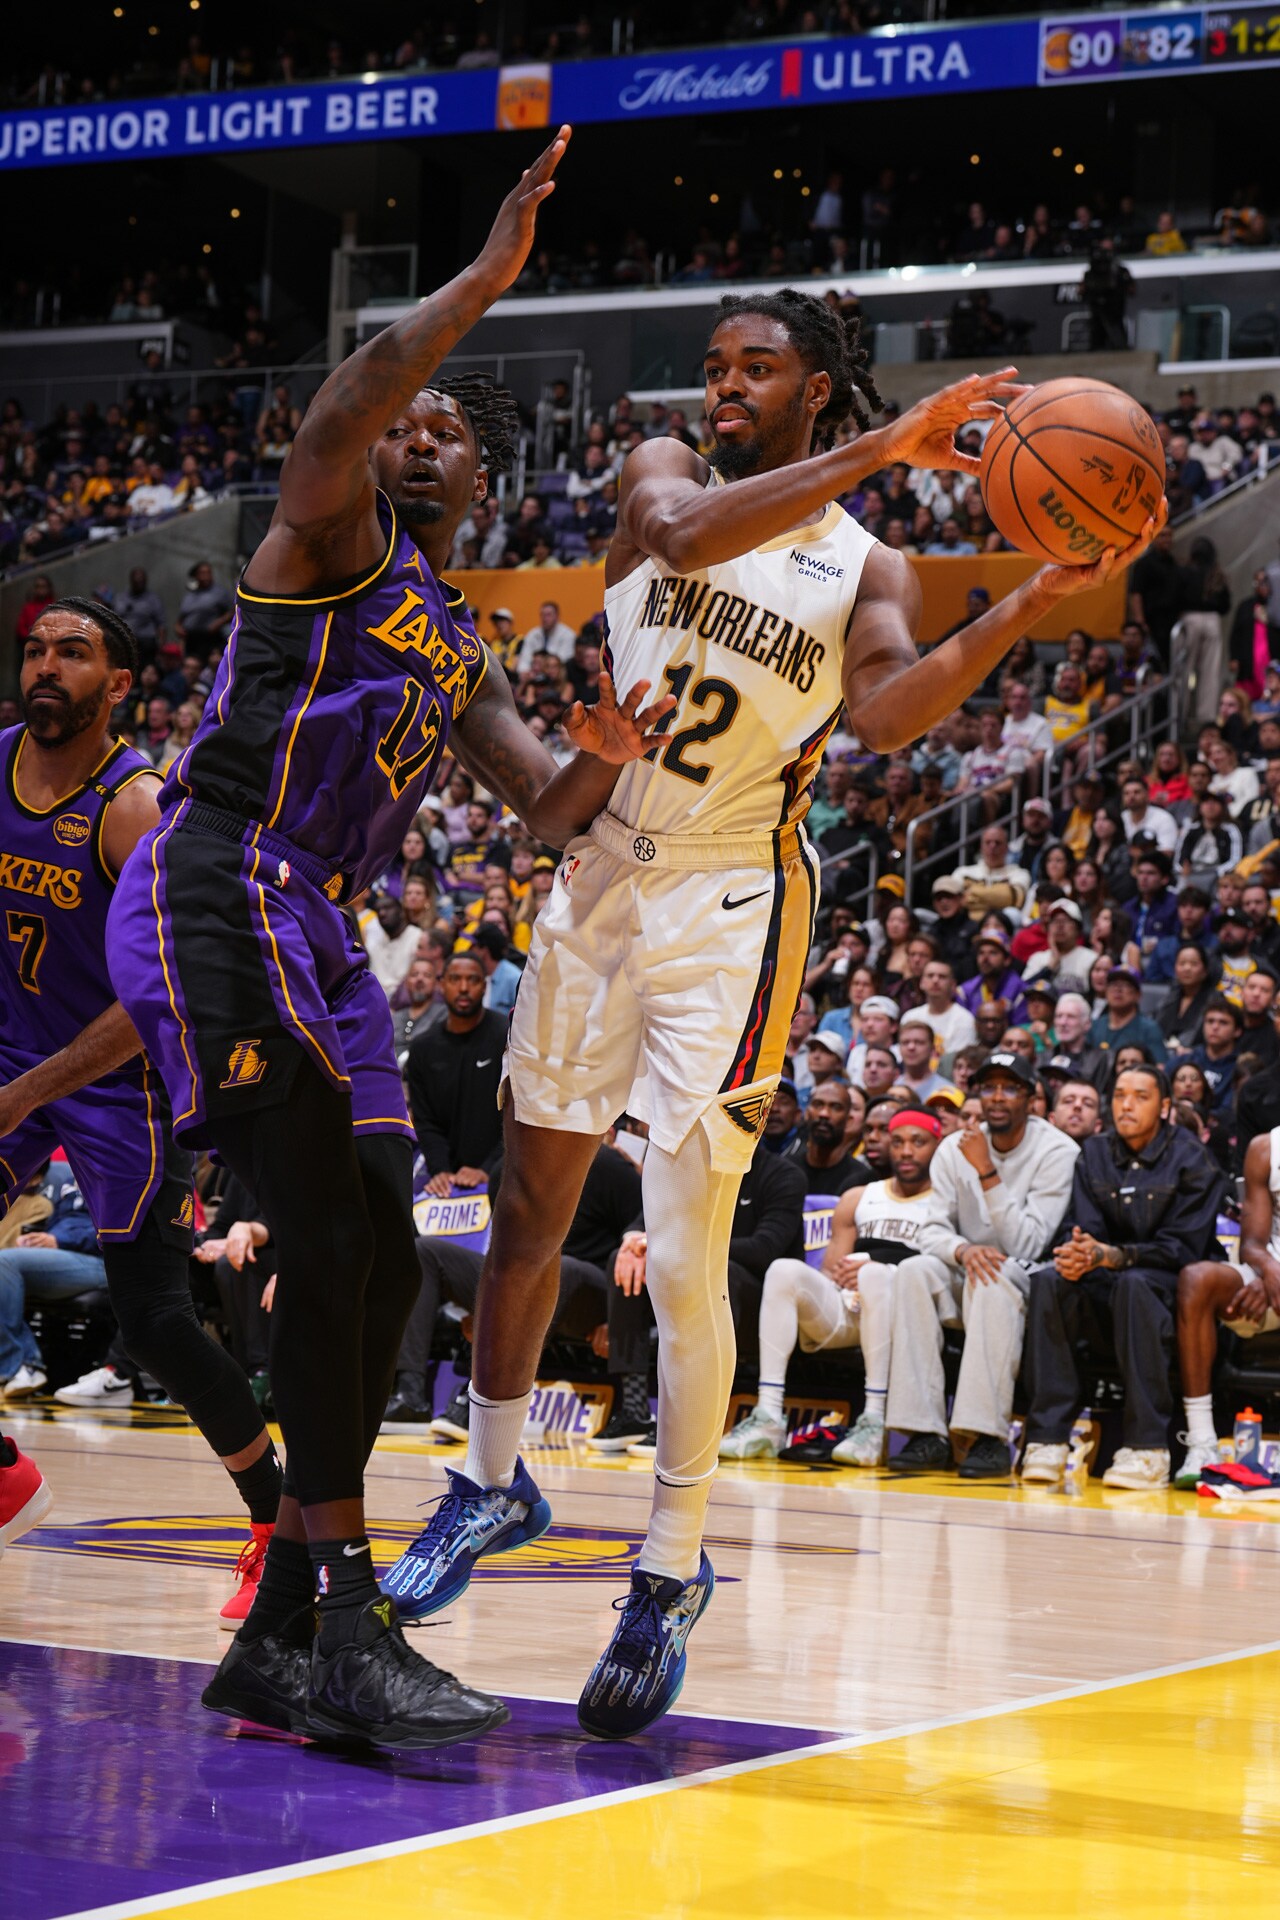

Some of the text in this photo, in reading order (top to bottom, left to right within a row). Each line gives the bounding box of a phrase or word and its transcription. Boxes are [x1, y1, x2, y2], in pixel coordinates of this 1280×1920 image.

[1068, 30, 1114, 68] 90
[1148, 23, 1194, 61] 82
[1210, 29, 1227, 56] 3
[618, 41, 970, 110] Michelob ULTRA
[185, 97, 310, 144] LIGHT
[326, 87, 439, 132] BEER
[1037, 486, 1112, 560] ilson
[798, 567, 828, 583] GRILLS
[640, 576, 826, 694] NEW ORLEANS
[375, 676, 442, 801] 17
[641, 661, 741, 788] 12
[57, 820, 89, 838] bibigo
[5, 909, 48, 996] 7
[426, 1202, 482, 1230] PRIME
[528, 1389, 596, 1433] RIME
